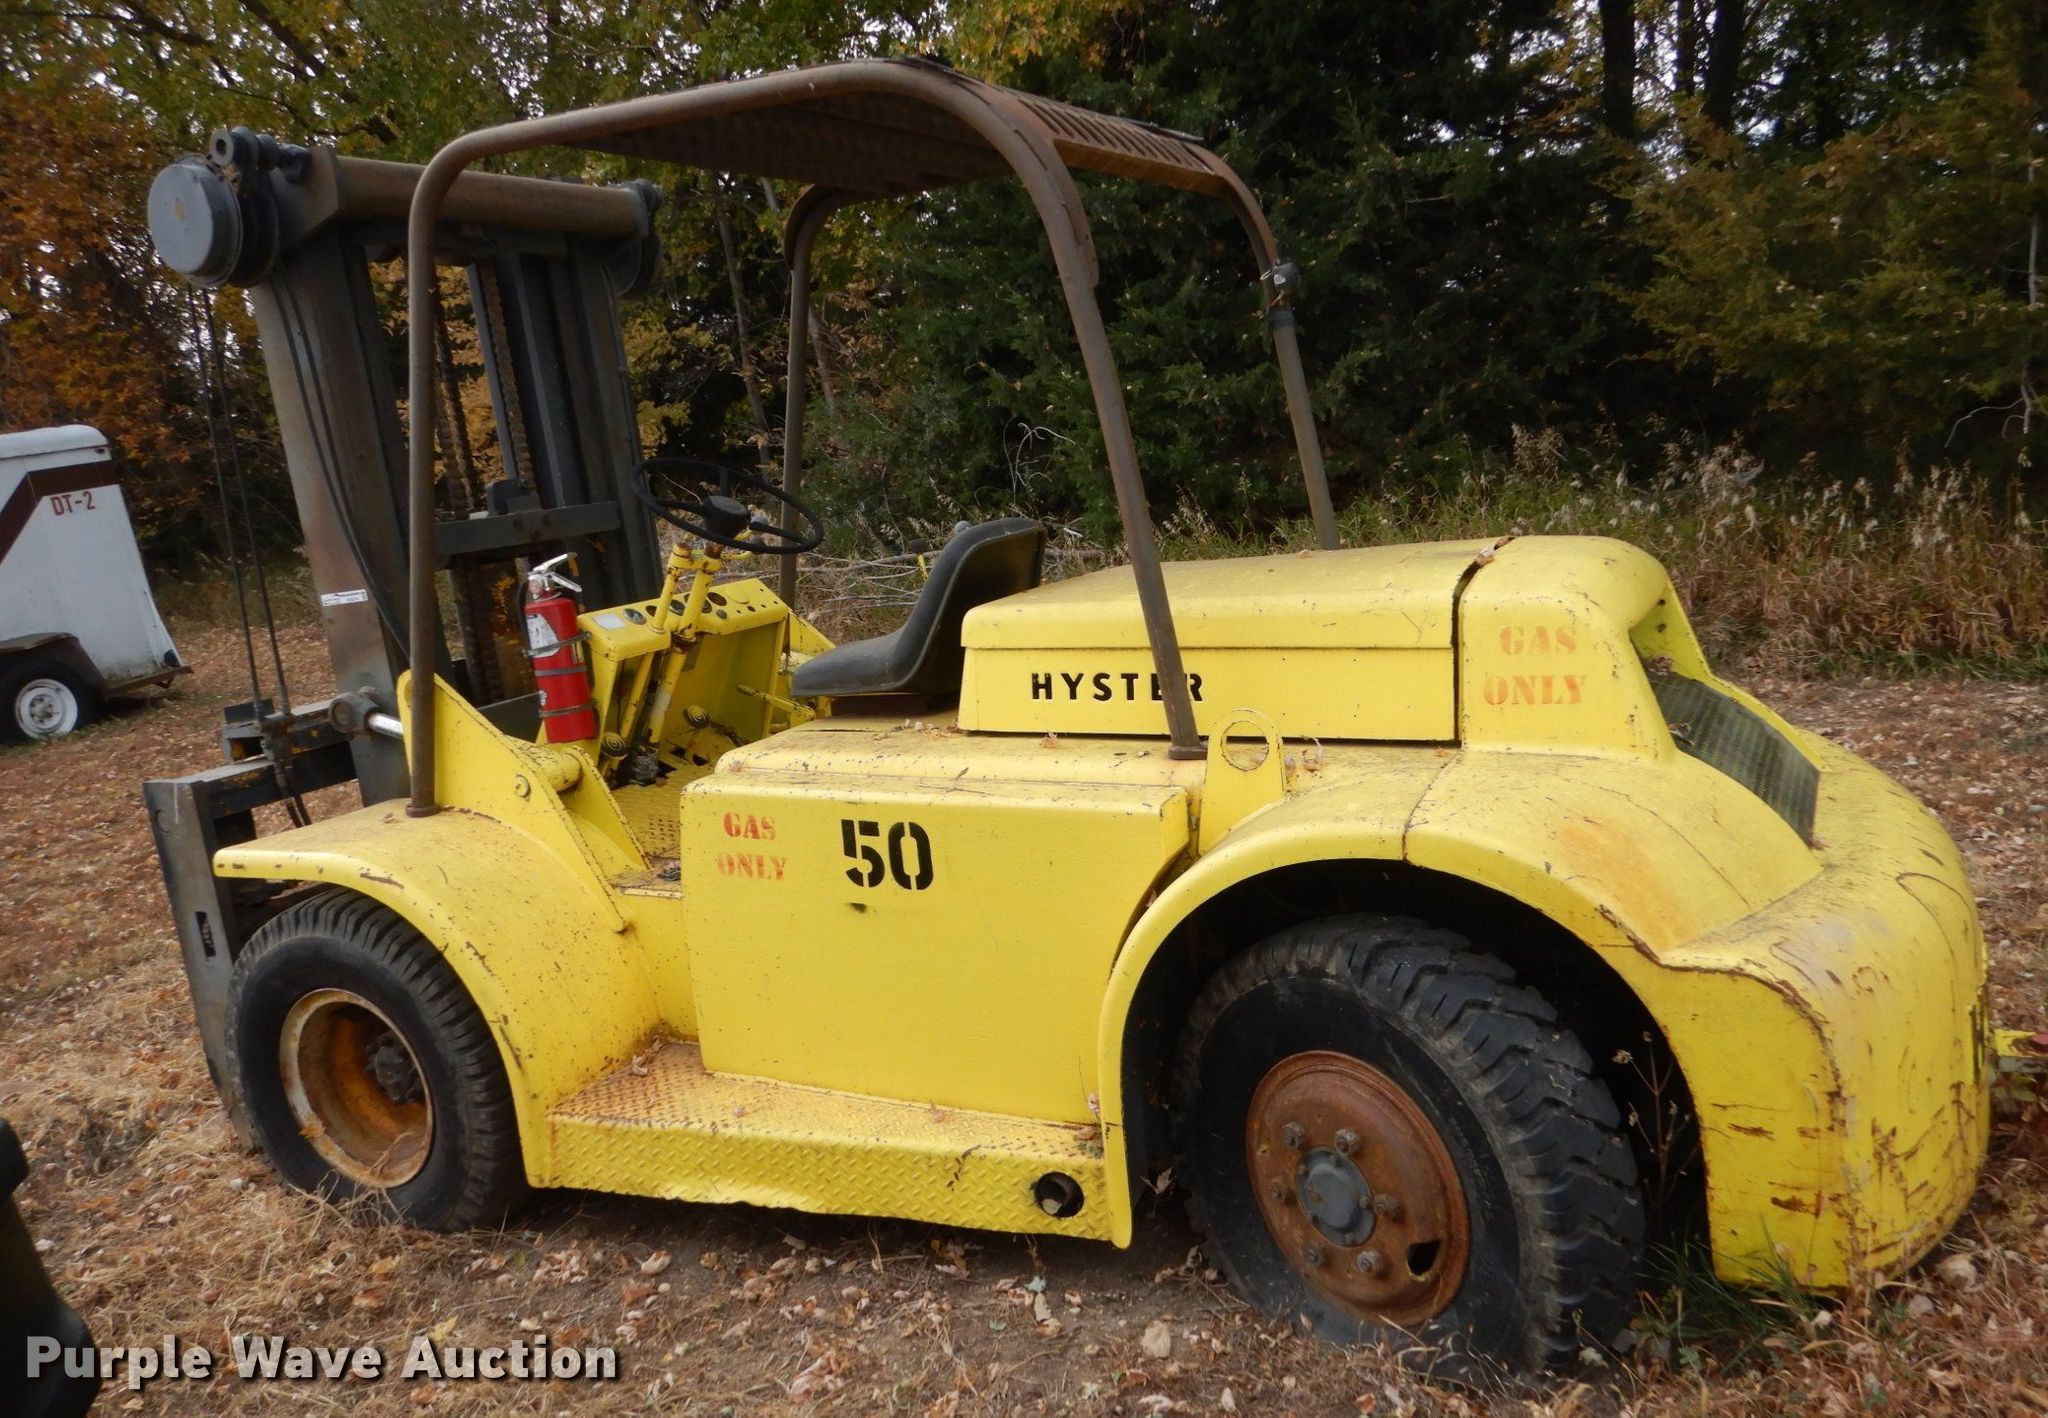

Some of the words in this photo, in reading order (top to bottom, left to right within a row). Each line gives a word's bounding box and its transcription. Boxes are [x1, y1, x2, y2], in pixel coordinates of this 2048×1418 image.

[50, 491, 95, 516] DT-2
[1500, 626, 1577, 655] GAS
[1483, 675, 1588, 705] ONLY
[723, 812, 776, 840] GAS
[717, 851, 787, 880] ONLY
[841, 819, 934, 890] 50
